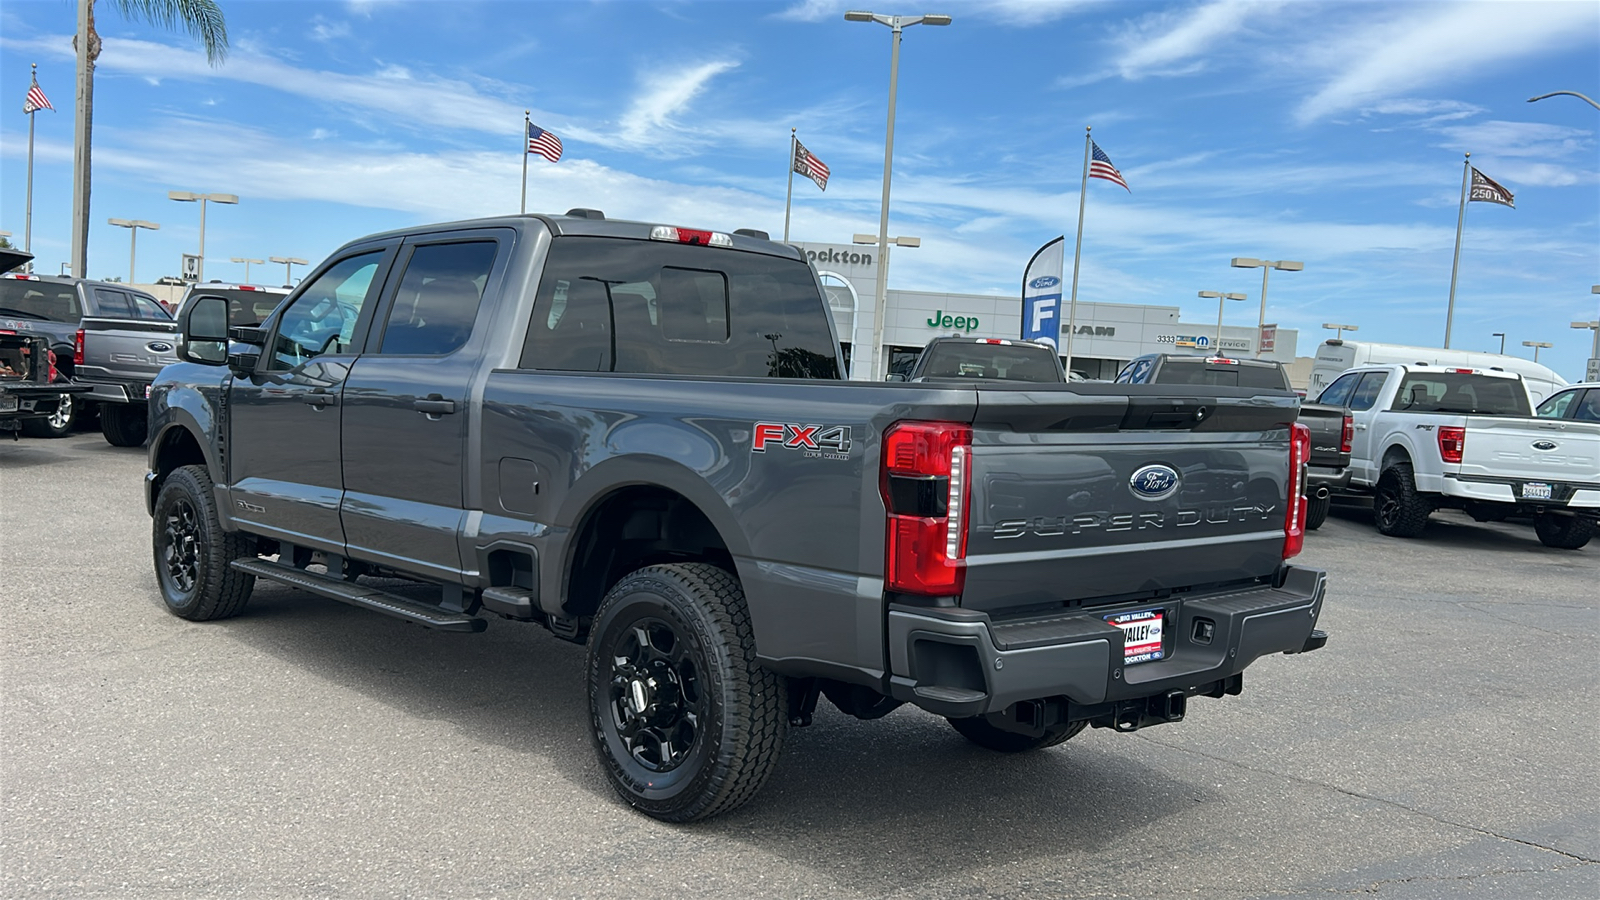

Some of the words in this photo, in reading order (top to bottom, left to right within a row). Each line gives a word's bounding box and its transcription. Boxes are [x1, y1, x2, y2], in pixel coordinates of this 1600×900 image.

[1472, 189, 1492, 200] 250
[801, 248, 872, 265] ockton
[183, 272, 198, 281] RAM
[927, 310, 979, 333] Jeep
[1061, 324, 1116, 337] RAM
[1156, 335, 1175, 344] 3333
[1212, 340, 1247, 349] Service
[752, 421, 852, 453] FX4
[1143, 471, 1170, 490] Ford
[993, 512, 1165, 539] SUPER
[1175, 504, 1277, 528] DUTY
[1119, 614, 1131, 622] BIG
[1131, 611, 1152, 620] VALLEY
[1124, 654, 1151, 662] OCKTON
